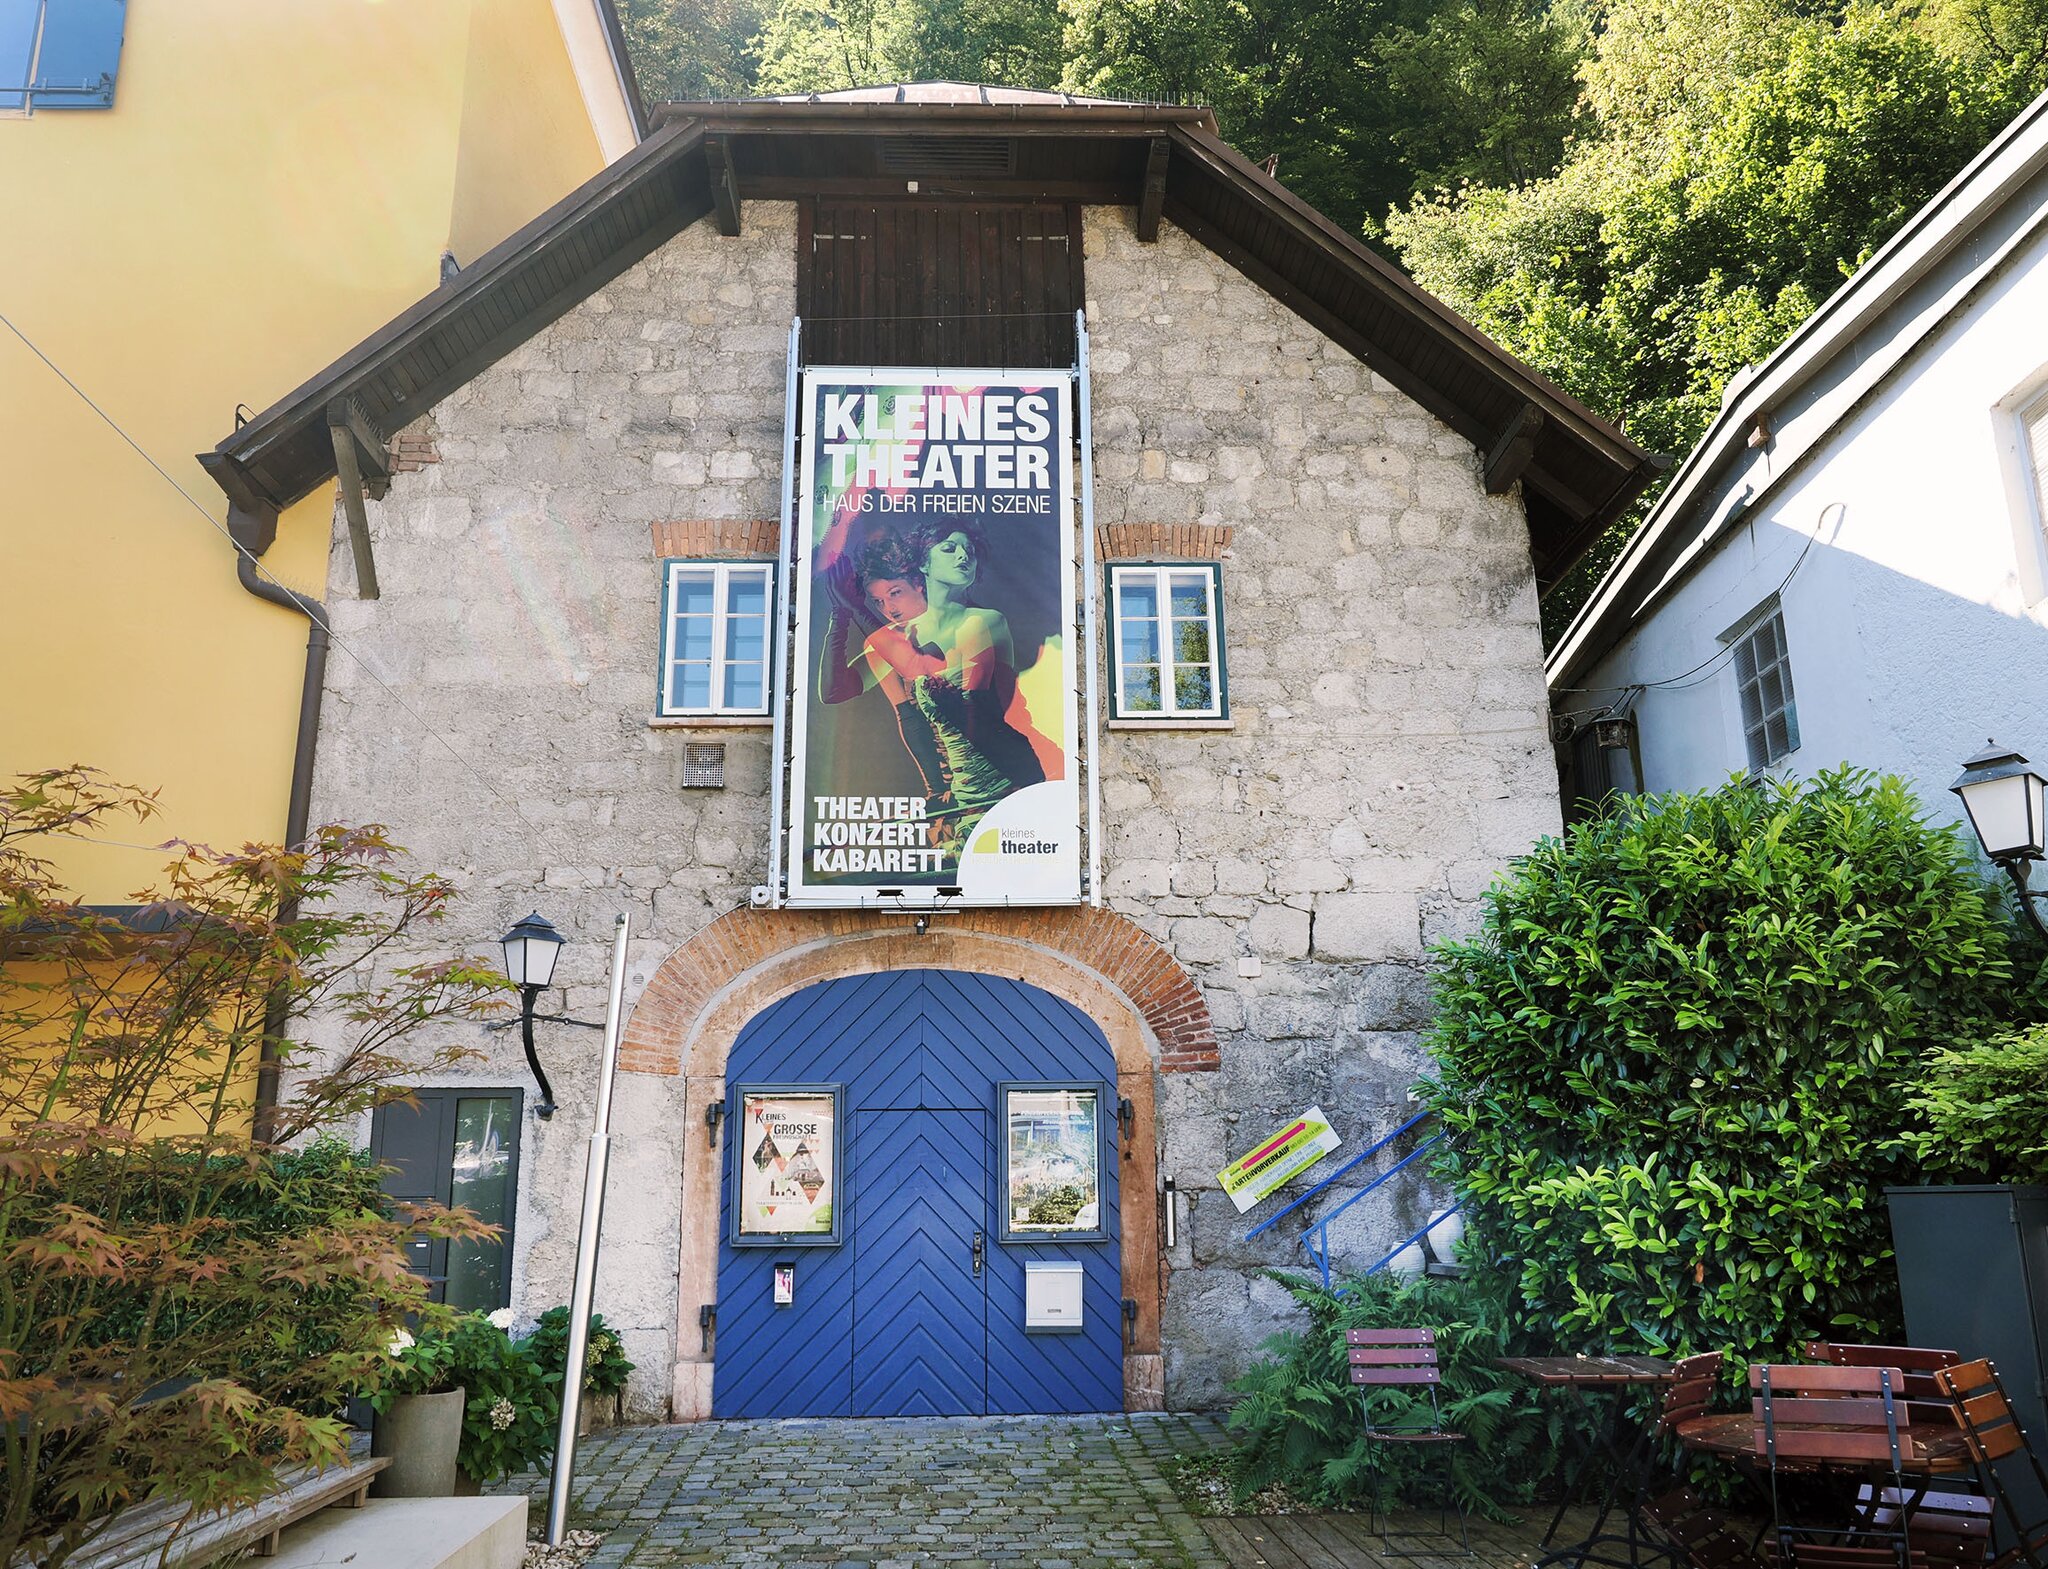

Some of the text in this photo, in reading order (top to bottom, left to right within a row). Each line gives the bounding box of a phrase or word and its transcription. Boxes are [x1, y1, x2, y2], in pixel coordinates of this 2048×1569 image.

[824, 394, 1051, 442] KLEINES
[823, 444, 1051, 489] THEATER
[823, 495, 1051, 514] HAUS DER FREIEN SZENE
[813, 796, 926, 820] THEATER
[813, 822, 930, 846] KONZERT
[1001, 828, 1035, 839] kleines
[1001, 840, 1059, 854] theater
[813, 848, 946, 872] KABARETT
[755, 1110, 787, 1124] KLEINES
[774, 1124, 817, 1135] GROSSE
[1232, 1144, 1291, 1191] KARTENVORVERKAUF
